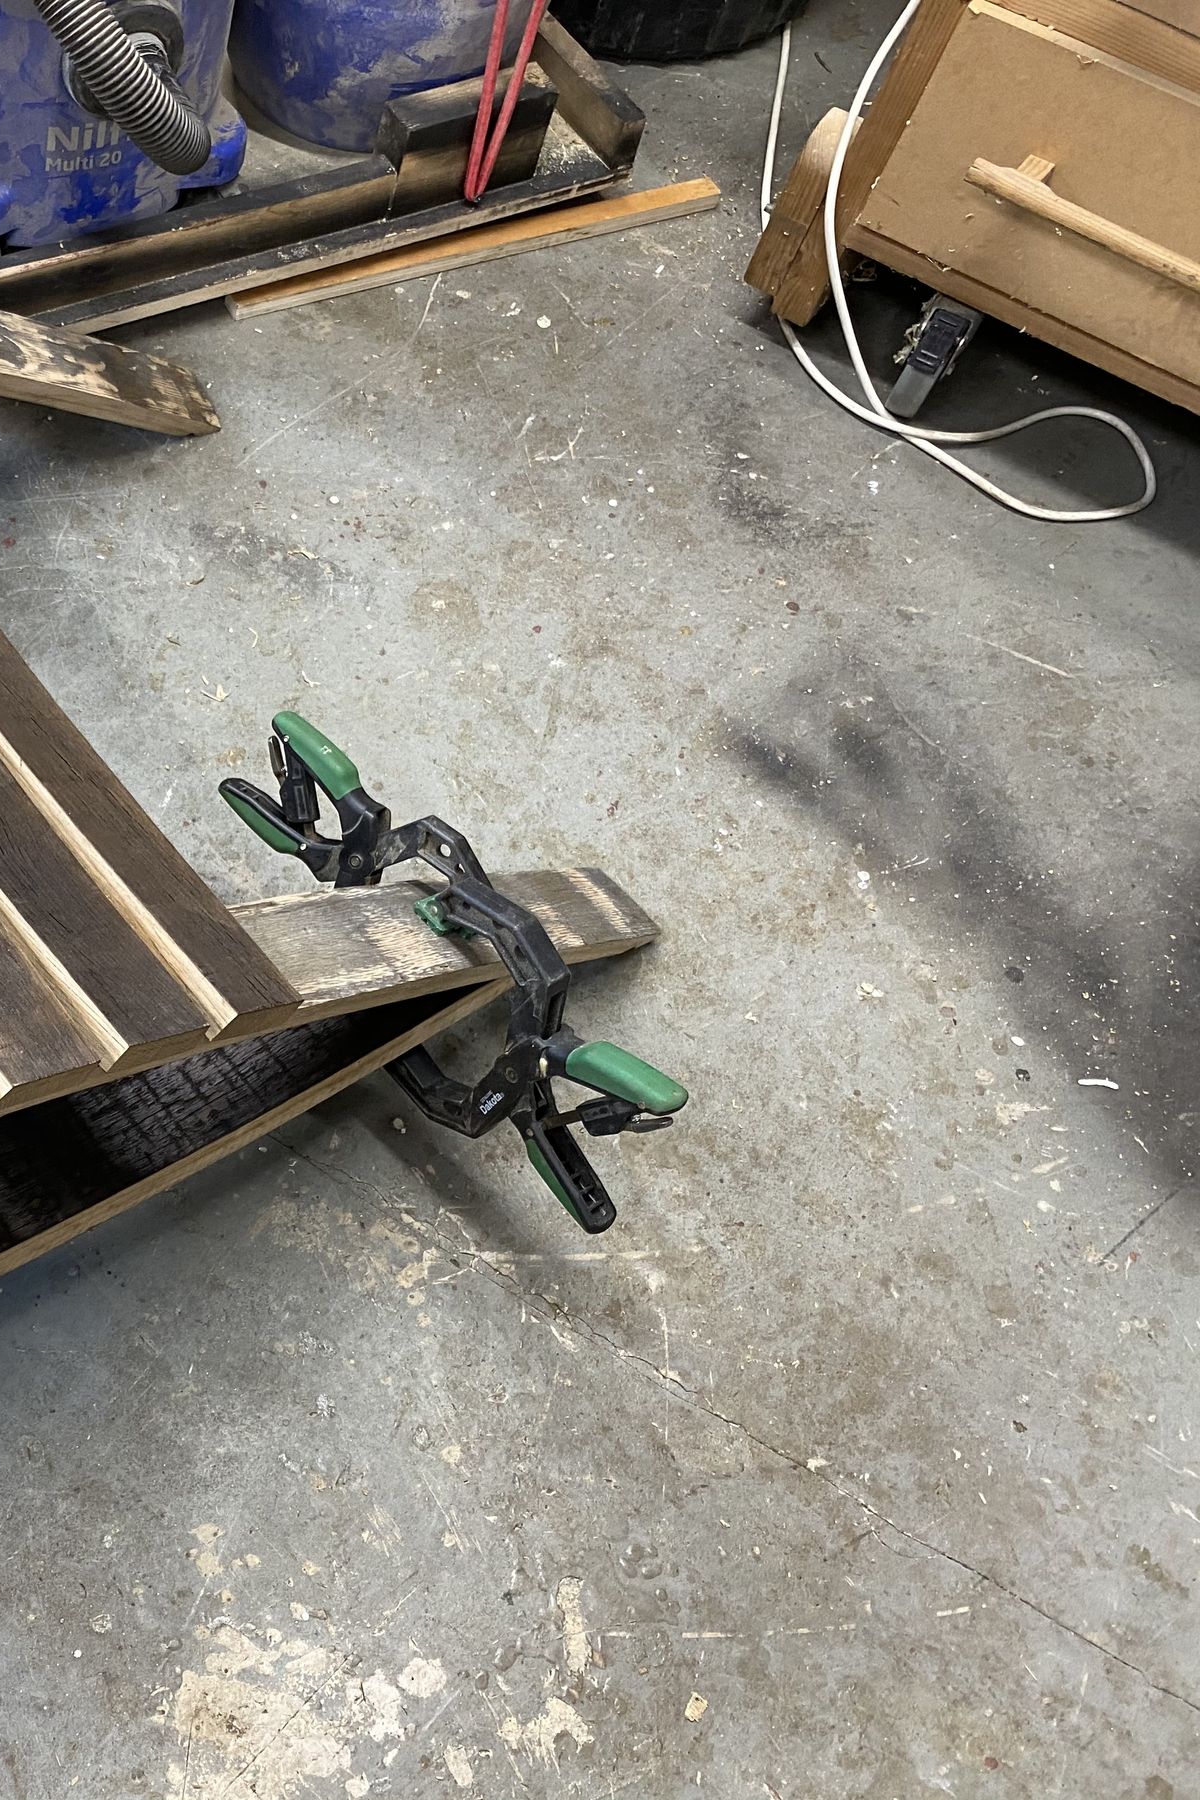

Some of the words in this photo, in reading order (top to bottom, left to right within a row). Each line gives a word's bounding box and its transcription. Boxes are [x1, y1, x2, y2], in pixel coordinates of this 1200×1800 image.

[46, 121, 130, 151] Nilf
[45, 155, 94, 172] Multi
[99, 150, 122, 168] 20
